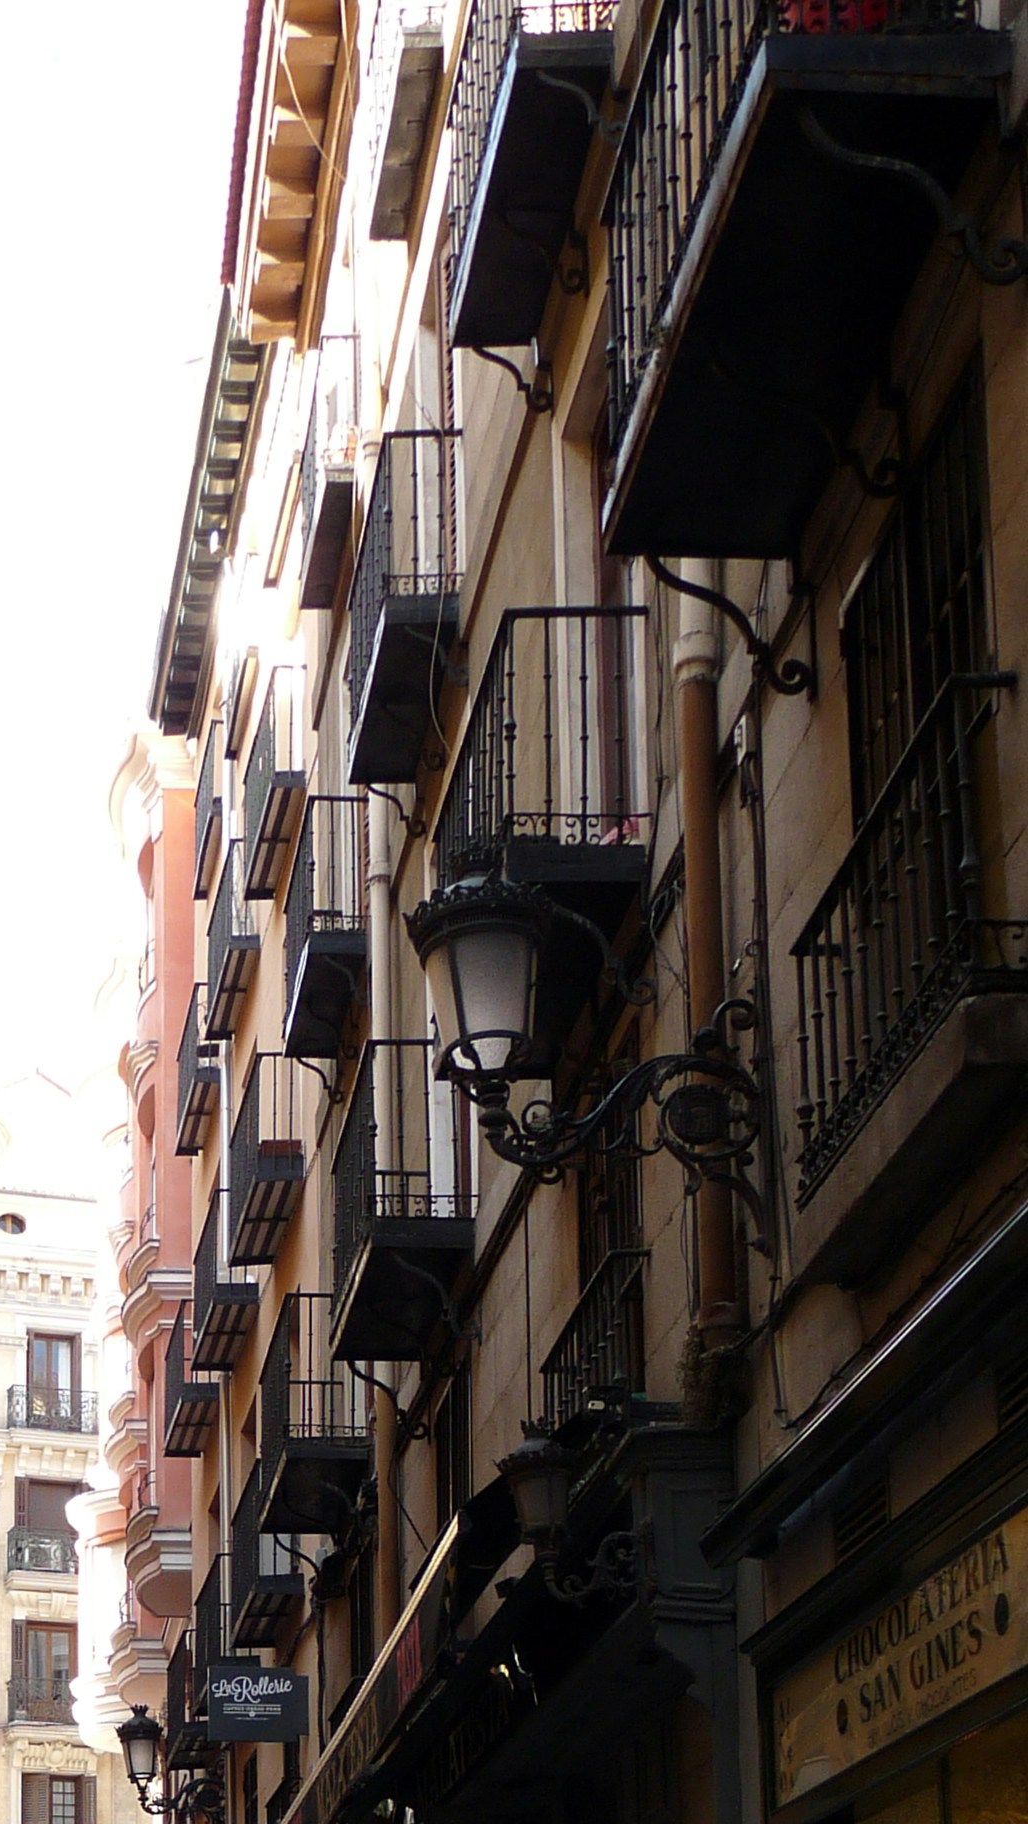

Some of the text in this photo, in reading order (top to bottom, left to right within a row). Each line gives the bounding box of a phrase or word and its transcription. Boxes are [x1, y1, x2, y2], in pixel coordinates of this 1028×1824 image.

[834, 1528, 1009, 1684] CHOCOLATERIA
[212, 1676, 293, 1704] La Rollerie
[859, 1610, 983, 1722] SAN GINES
